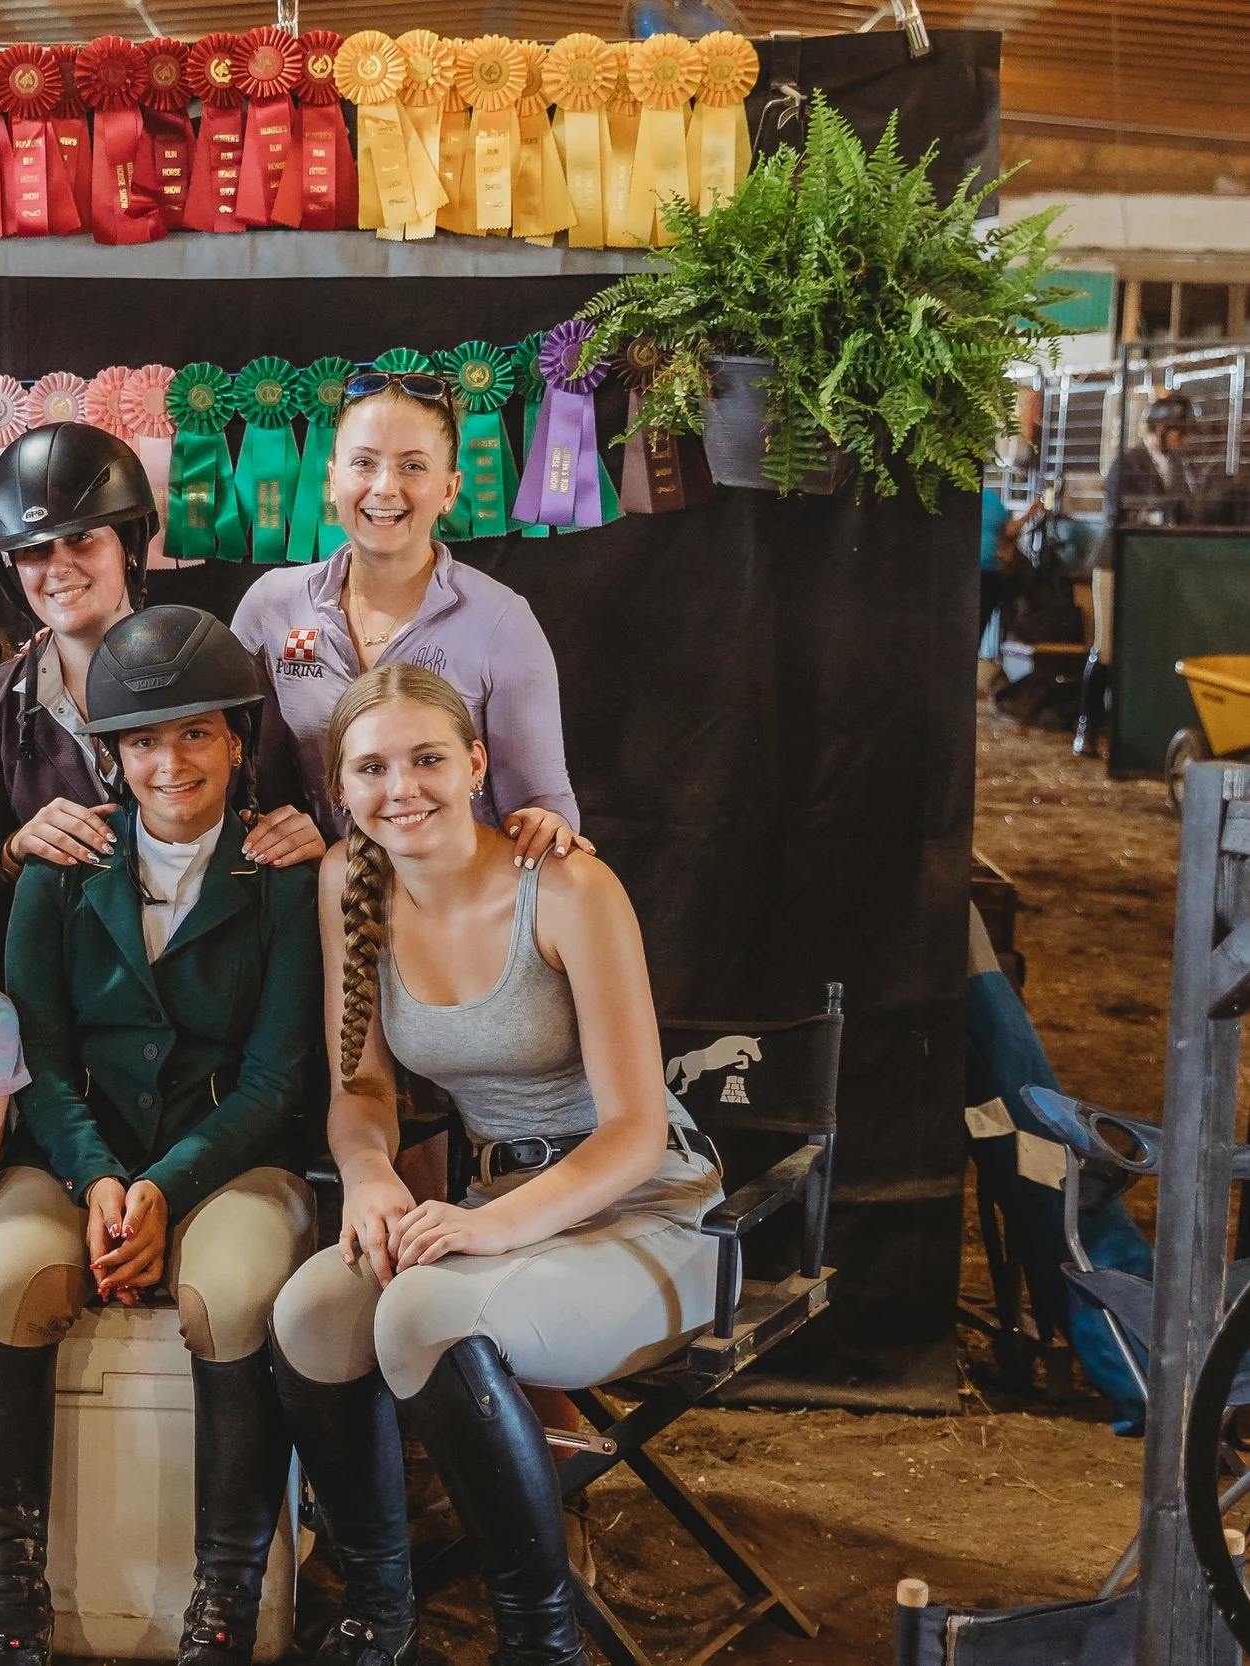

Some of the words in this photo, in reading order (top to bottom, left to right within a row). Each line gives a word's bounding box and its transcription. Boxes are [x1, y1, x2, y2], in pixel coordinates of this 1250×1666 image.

[260, 126, 287, 135] HUNTER'S
[270, 144, 282, 152] RUN
[221, 152, 233, 160] RUN
[162, 168, 181, 176] HORSE
[218, 170, 237, 178] HORSE
[164, 186, 181, 194] SHOW
[220, 187, 235, 196] SHOW
[22, 192, 40, 200] SHOW
[119, 189, 129, 209] SHOW
[550, 471, 558, 491] SHOW
[276, 658, 323, 678] PURINA
